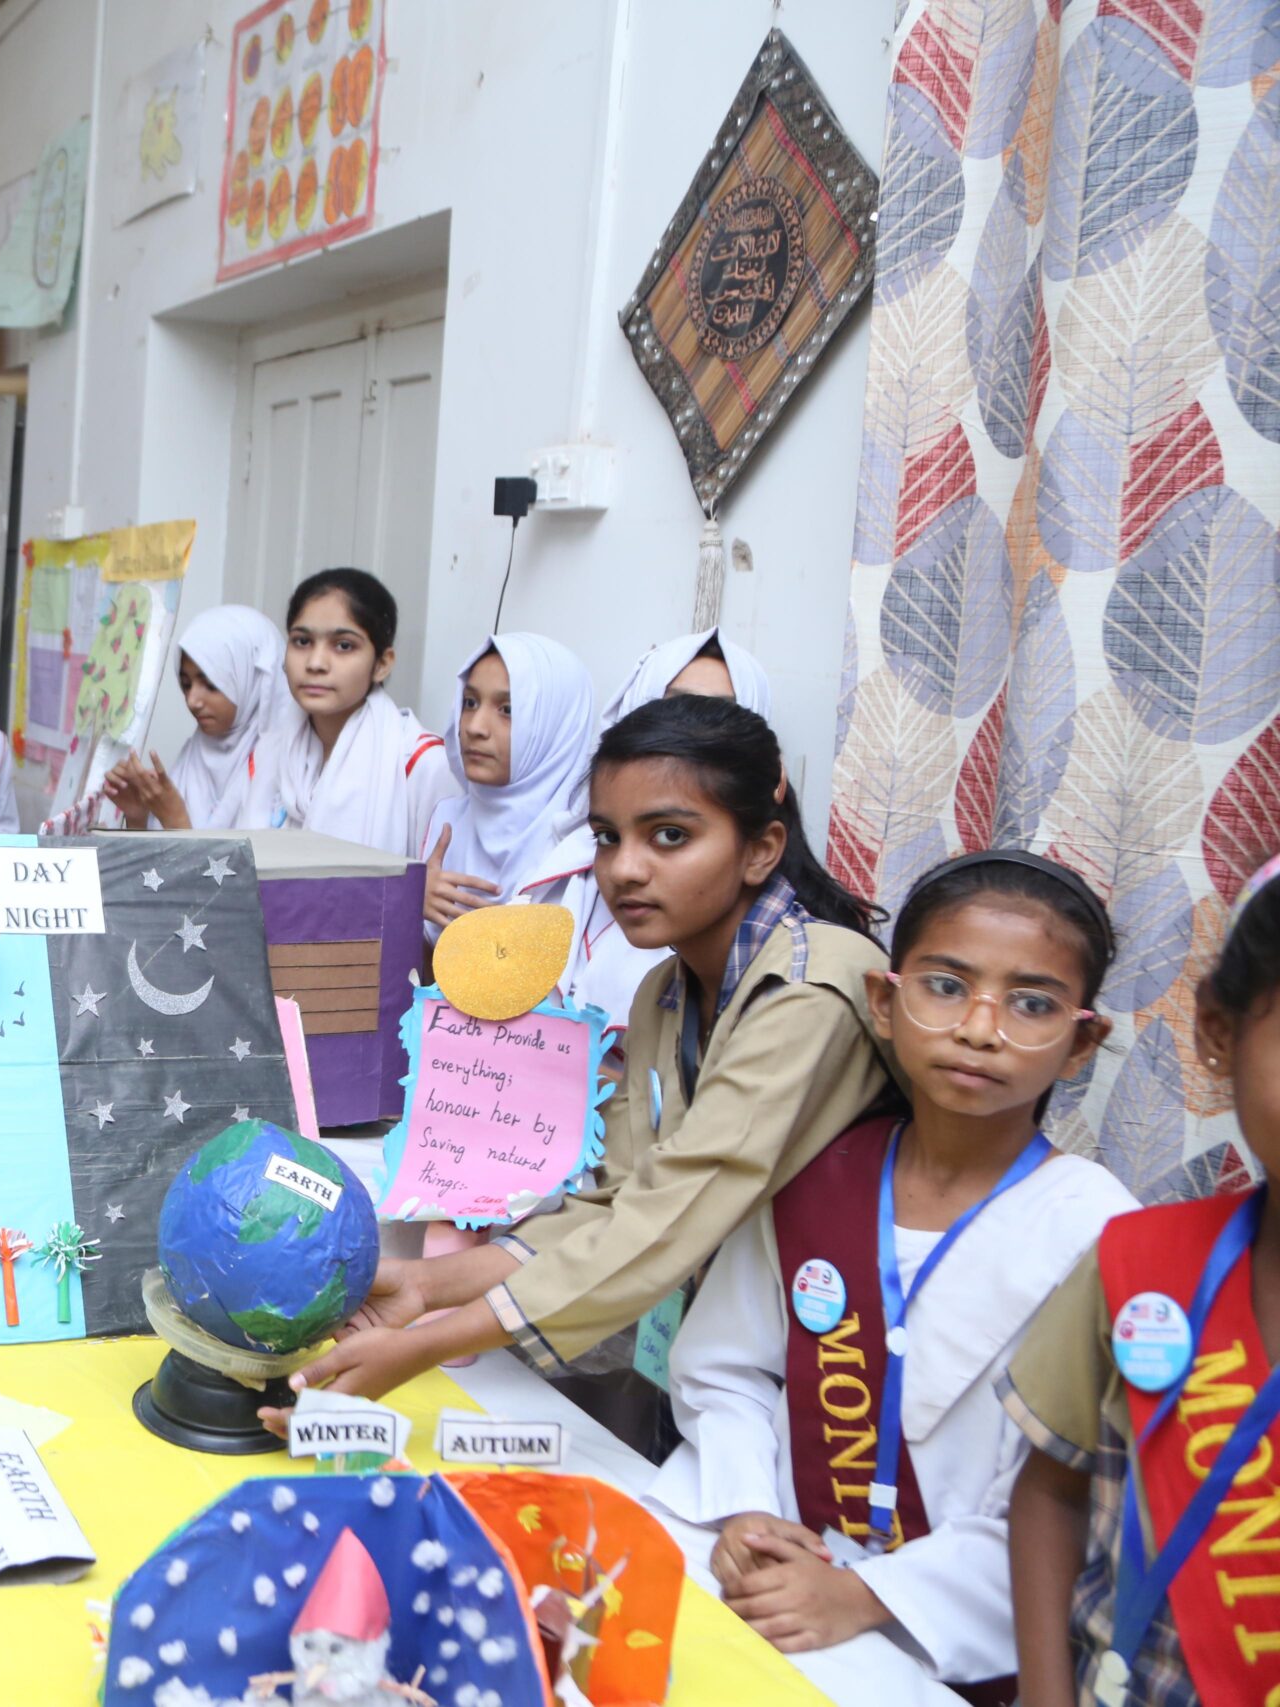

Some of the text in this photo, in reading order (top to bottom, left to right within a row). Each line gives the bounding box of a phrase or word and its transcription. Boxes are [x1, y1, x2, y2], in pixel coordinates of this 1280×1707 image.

[13, 858, 73, 883] DAY
[5, 907, 88, 929] NIGHT
[428, 1005, 483, 1036] Earth
[558, 1043, 571, 1054] us
[425, 1088, 557, 1145] honour her by
[487, 1147, 547, 1172] natural
[275, 1165, 332, 1201] EARTH
[297, 1422, 388, 1444] WINTER
[452, 1435, 552, 1454] AUTUMN
[1179, 1340, 1280, 1707] MONI
